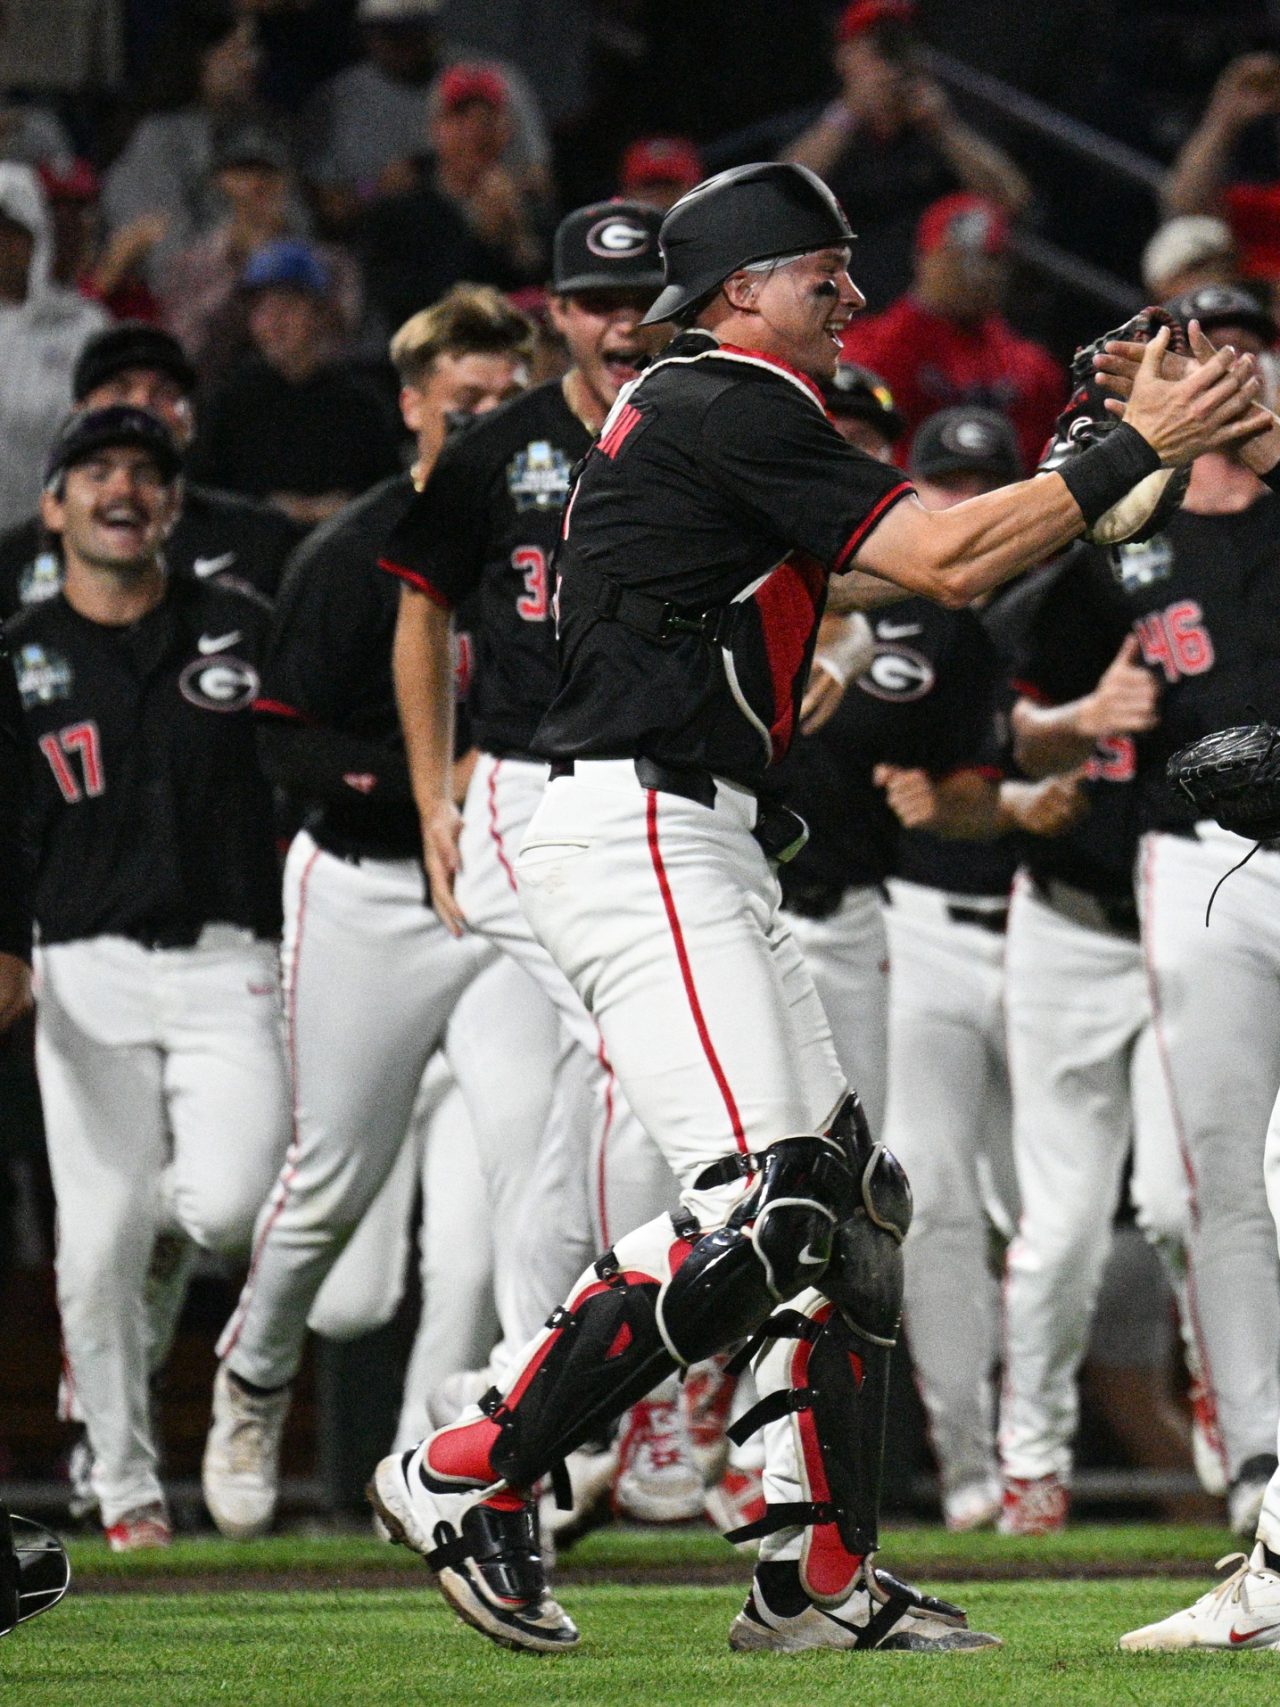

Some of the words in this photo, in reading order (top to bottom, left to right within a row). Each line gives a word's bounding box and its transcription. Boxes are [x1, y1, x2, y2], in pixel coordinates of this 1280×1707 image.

[511, 544, 553, 621] 3
[1132, 600, 1215, 683] 46
[38, 719, 105, 803] 17
